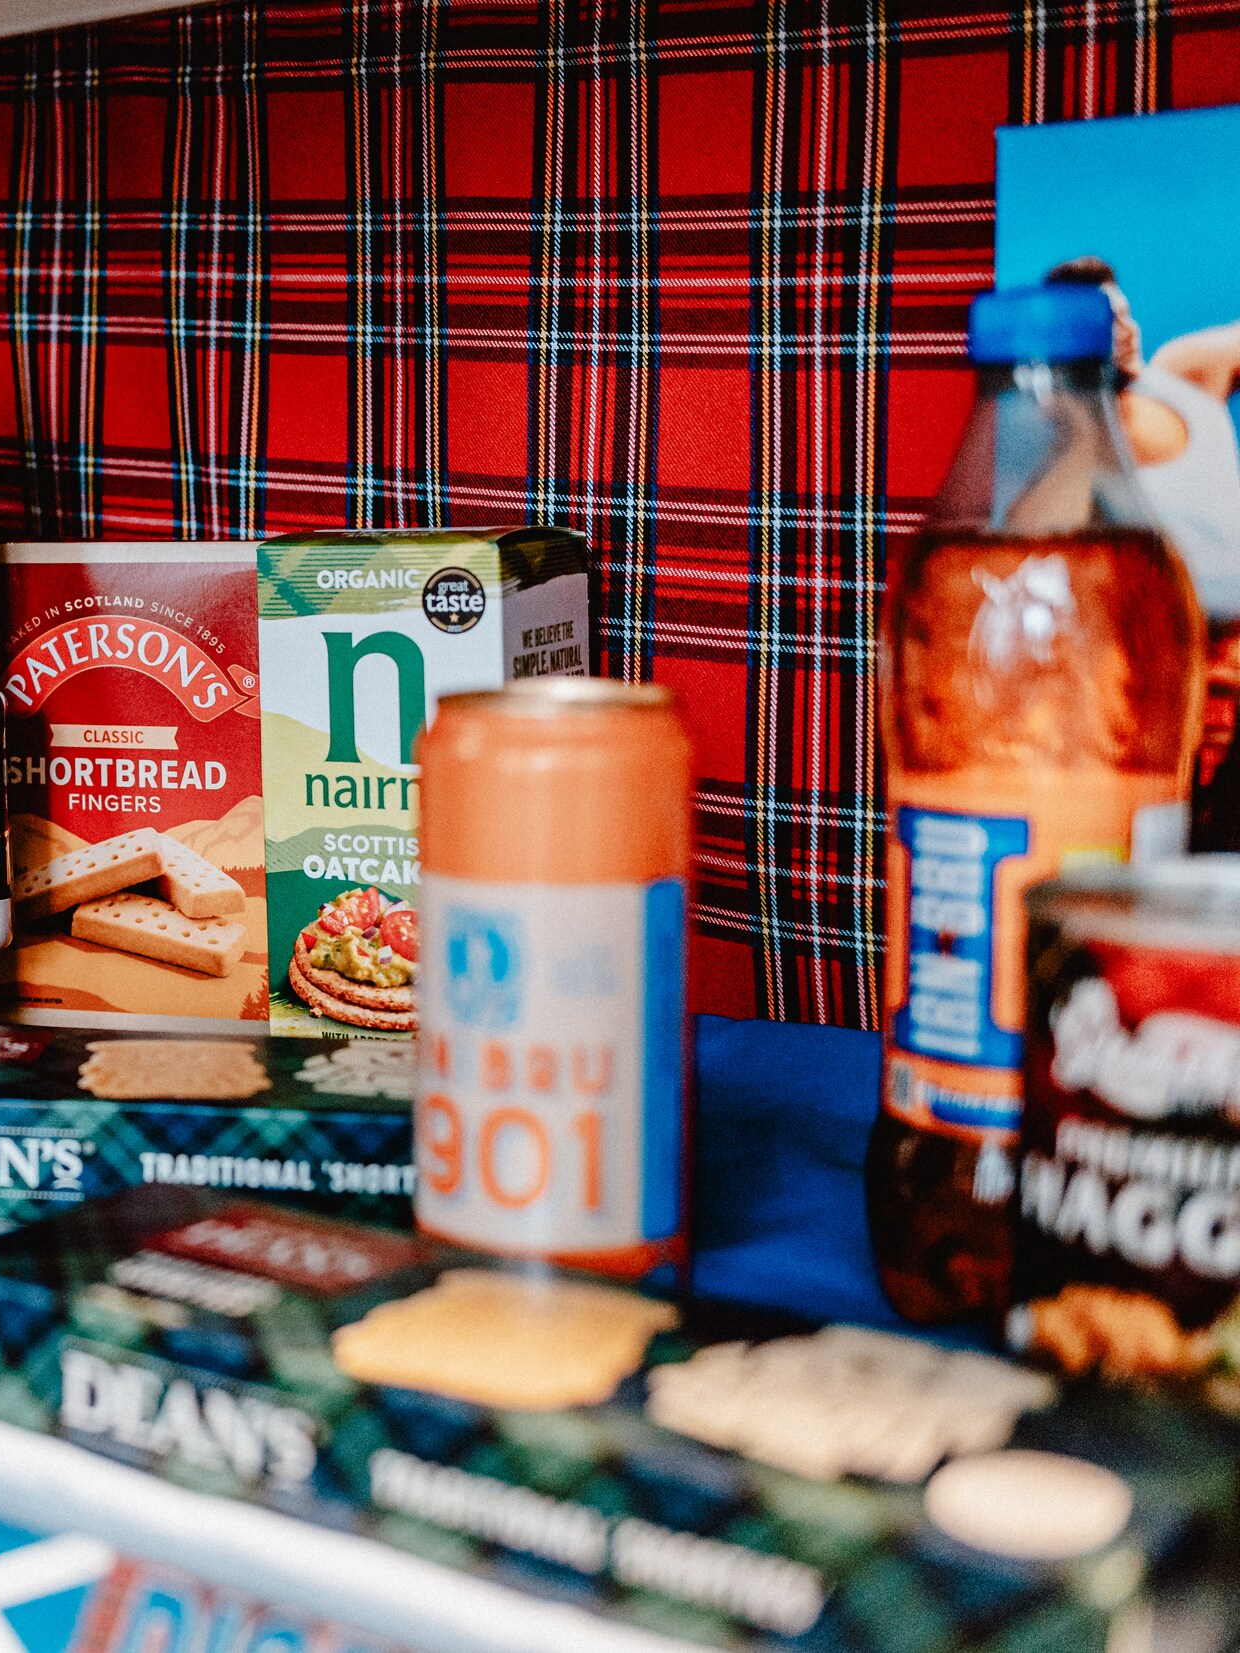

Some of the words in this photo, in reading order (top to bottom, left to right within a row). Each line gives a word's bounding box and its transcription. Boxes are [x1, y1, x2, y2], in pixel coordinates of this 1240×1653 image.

[316, 569, 421, 590] ORGANIC
[437, 580, 470, 596] great
[425, 592, 484, 613] taste
[45, 605, 61, 620] IN
[64, 596, 145, 612] SCOTLAND
[150, 601, 194, 629] SINCE
[195, 625, 227, 655] 1895
[6, 622, 228, 708] PATERSON'S
[550, 644, 583, 673] NATURAL
[83, 729, 144, 744] CLASSIC
[7, 756, 227, 790] SHORTBREAD
[68, 793, 161, 813] FINGERS
[324, 833, 420, 856] SCOTTIS
[303, 854, 423, 886] OATCAK
[139, 1152, 316, 1192] TRADITIONAL
[321, 1159, 418, 1195] 'SHORT
